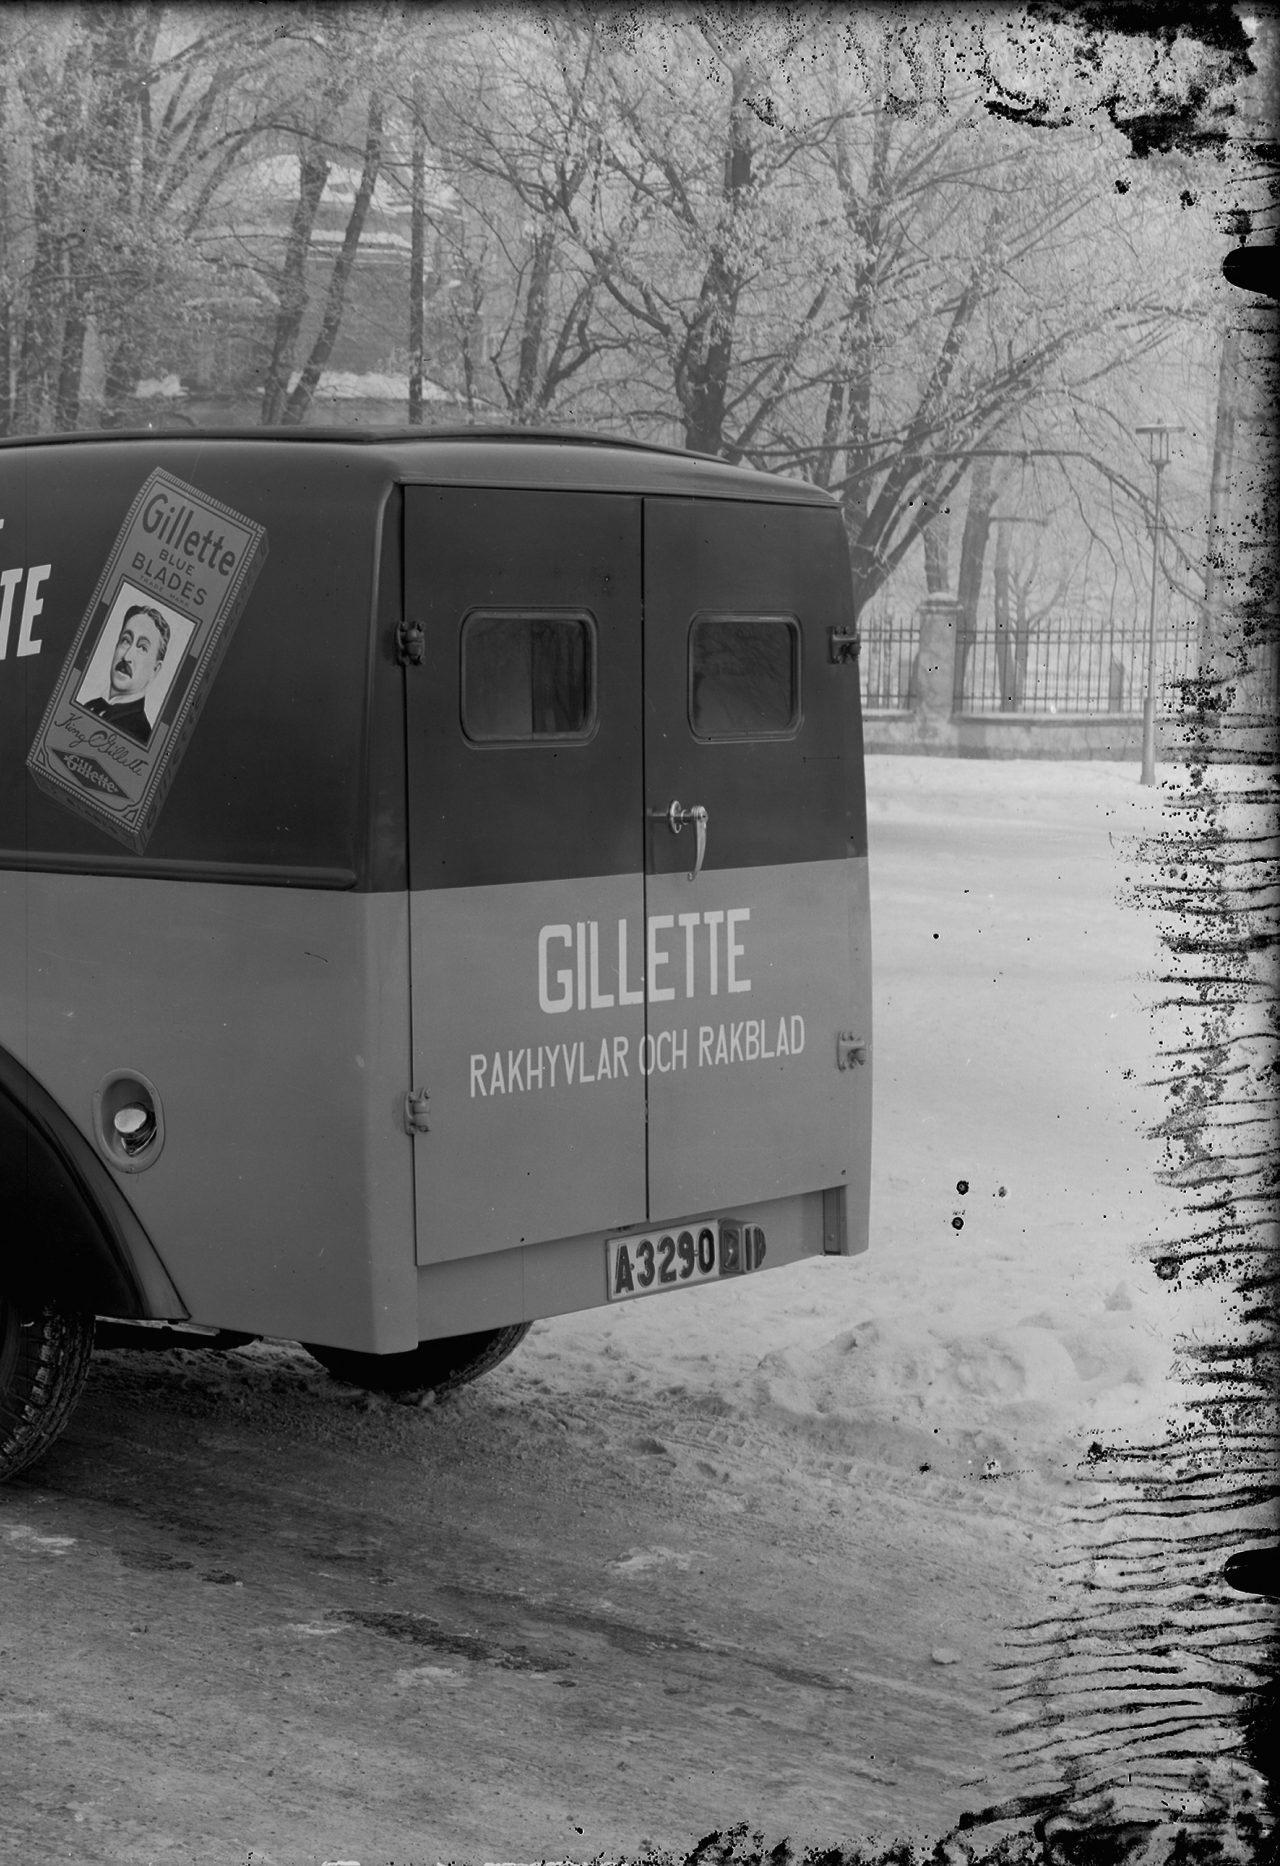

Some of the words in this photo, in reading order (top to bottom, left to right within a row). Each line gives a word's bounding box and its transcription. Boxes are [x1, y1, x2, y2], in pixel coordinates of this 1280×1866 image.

[142, 493, 237, 577] Gillette
[159, 548, 195, 577] BLUE
[131, 551, 208, 606] BLADES
[66, 755, 117, 793] Gillette
[538, 907, 752, 1014] GILLETTE
[470, 1035, 629, 1098] RAKHYVLAR
[638, 1028, 688, 1076] OCH
[698, 1014, 806, 1067] RAKBLAD
